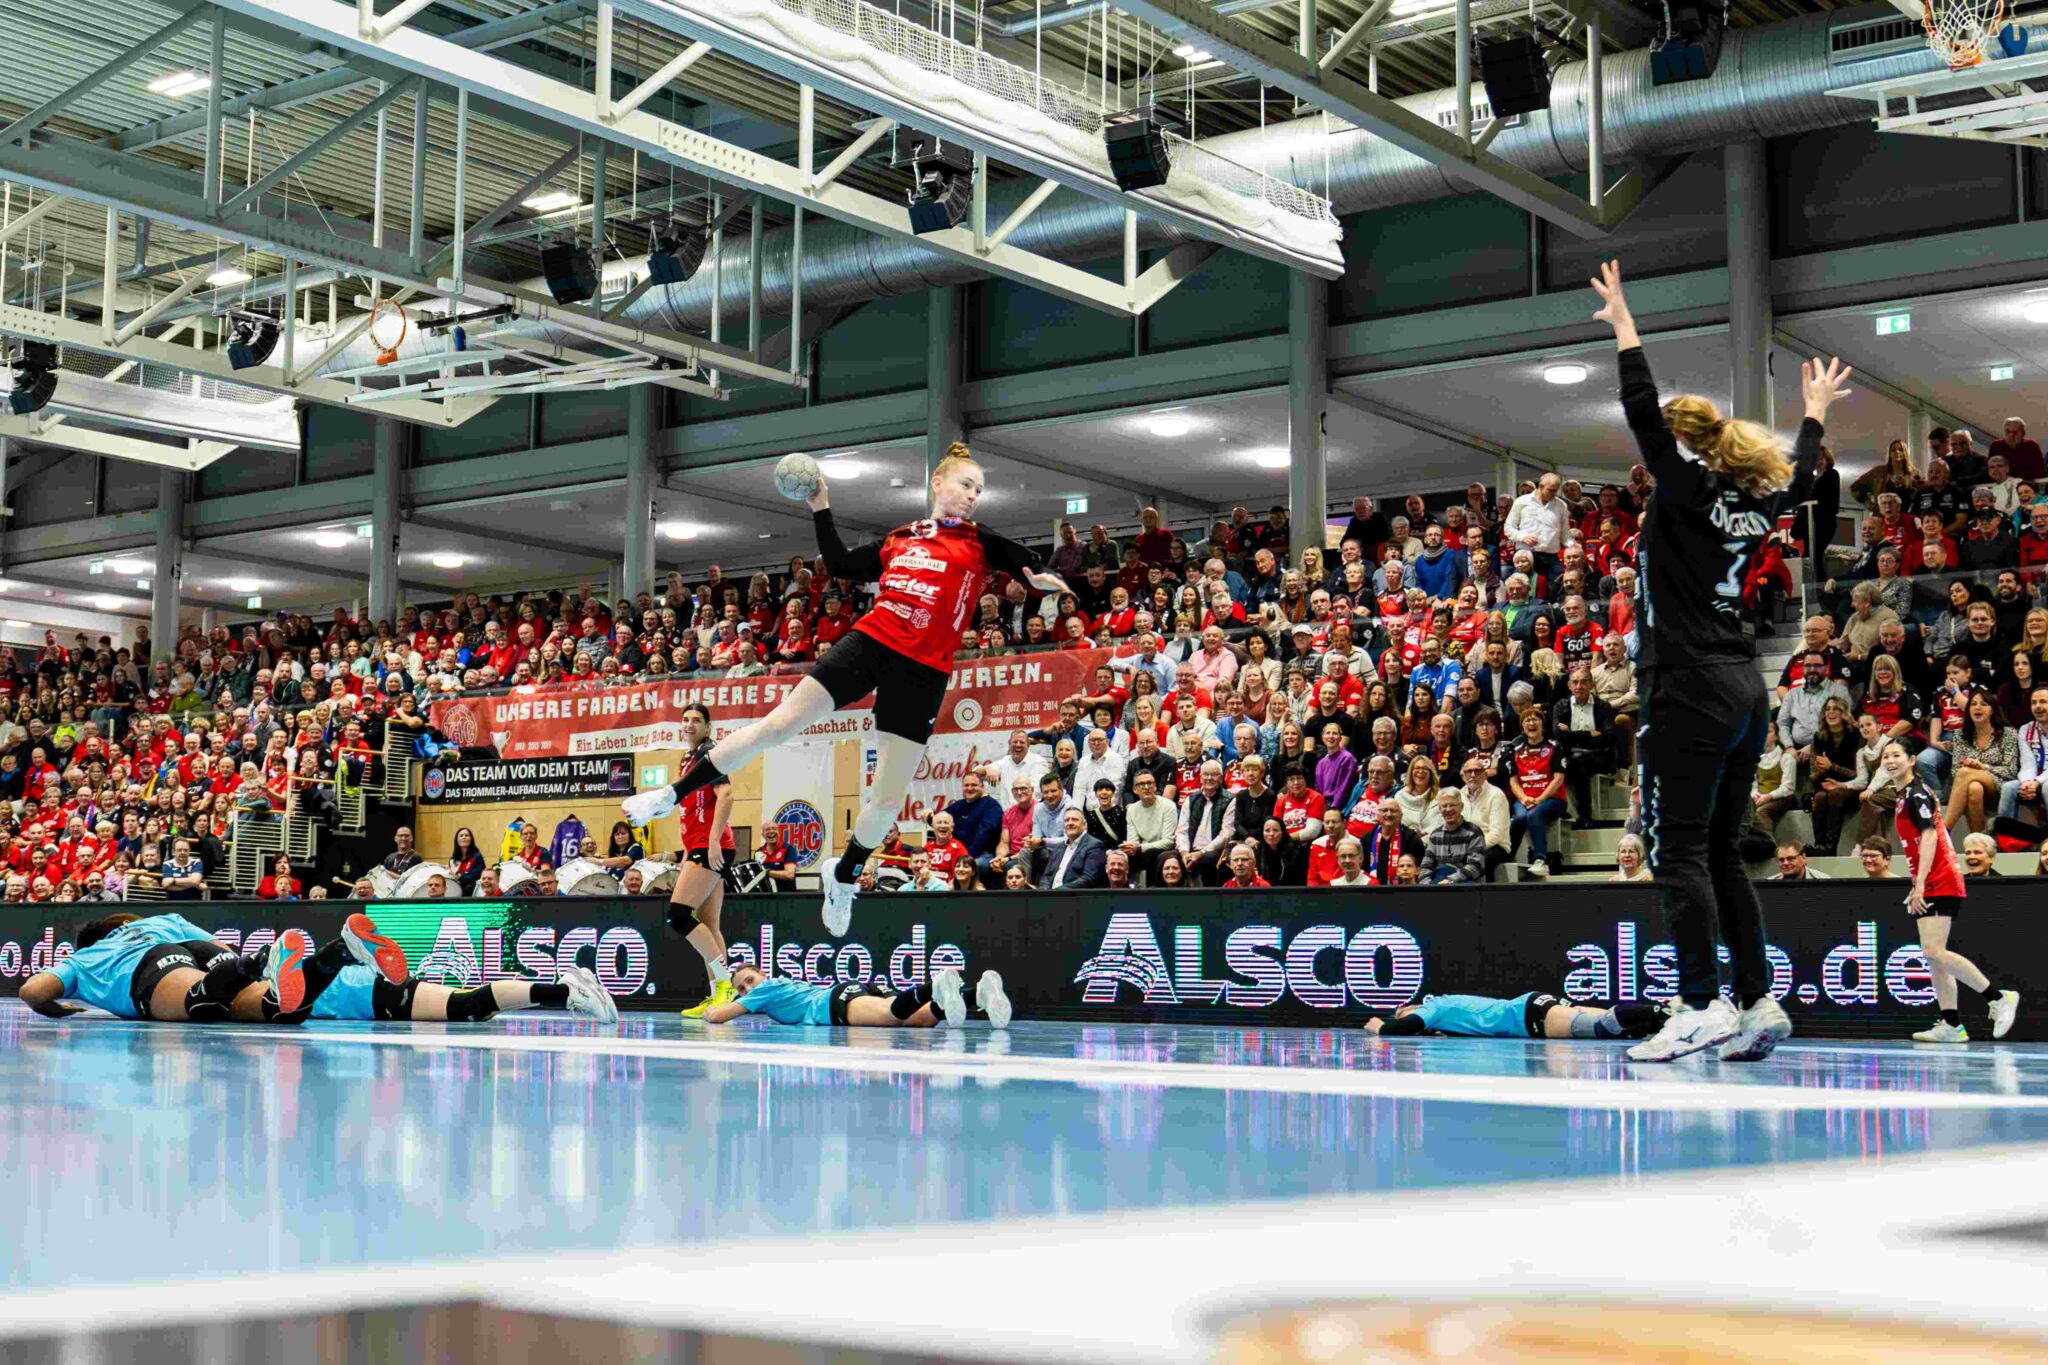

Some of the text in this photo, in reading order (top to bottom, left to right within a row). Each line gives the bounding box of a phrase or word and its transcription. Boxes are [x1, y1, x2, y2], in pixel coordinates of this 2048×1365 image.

[1567, 639, 1584, 651] 60
[495, 699, 572, 722] UNSERE
[577, 691, 664, 717] FARBEN.
[672, 684, 757, 709] UNSERE
[946, 662, 1053, 691] VEREIN.
[576, 739, 592, 752] Ein
[594, 736, 627, 751] Leben
[630, 733, 649, 748] lang
[651, 729, 673, 744] Rote
[862, 716, 873, 731] &
[446, 759, 609, 782] DAS TEAM VOR DEM TEAM
[445, 787, 461, 798] DAS
[461, 783, 562, 797] TROMMLER-AUFBAUTEAM
[561, 838, 579, 858] 16
[778, 821, 821, 851] THC
[416, 917, 649, 996] ALSCO
[727, 923, 967, 992] alsco.de
[1073, 913, 1423, 1009] ALSCO
